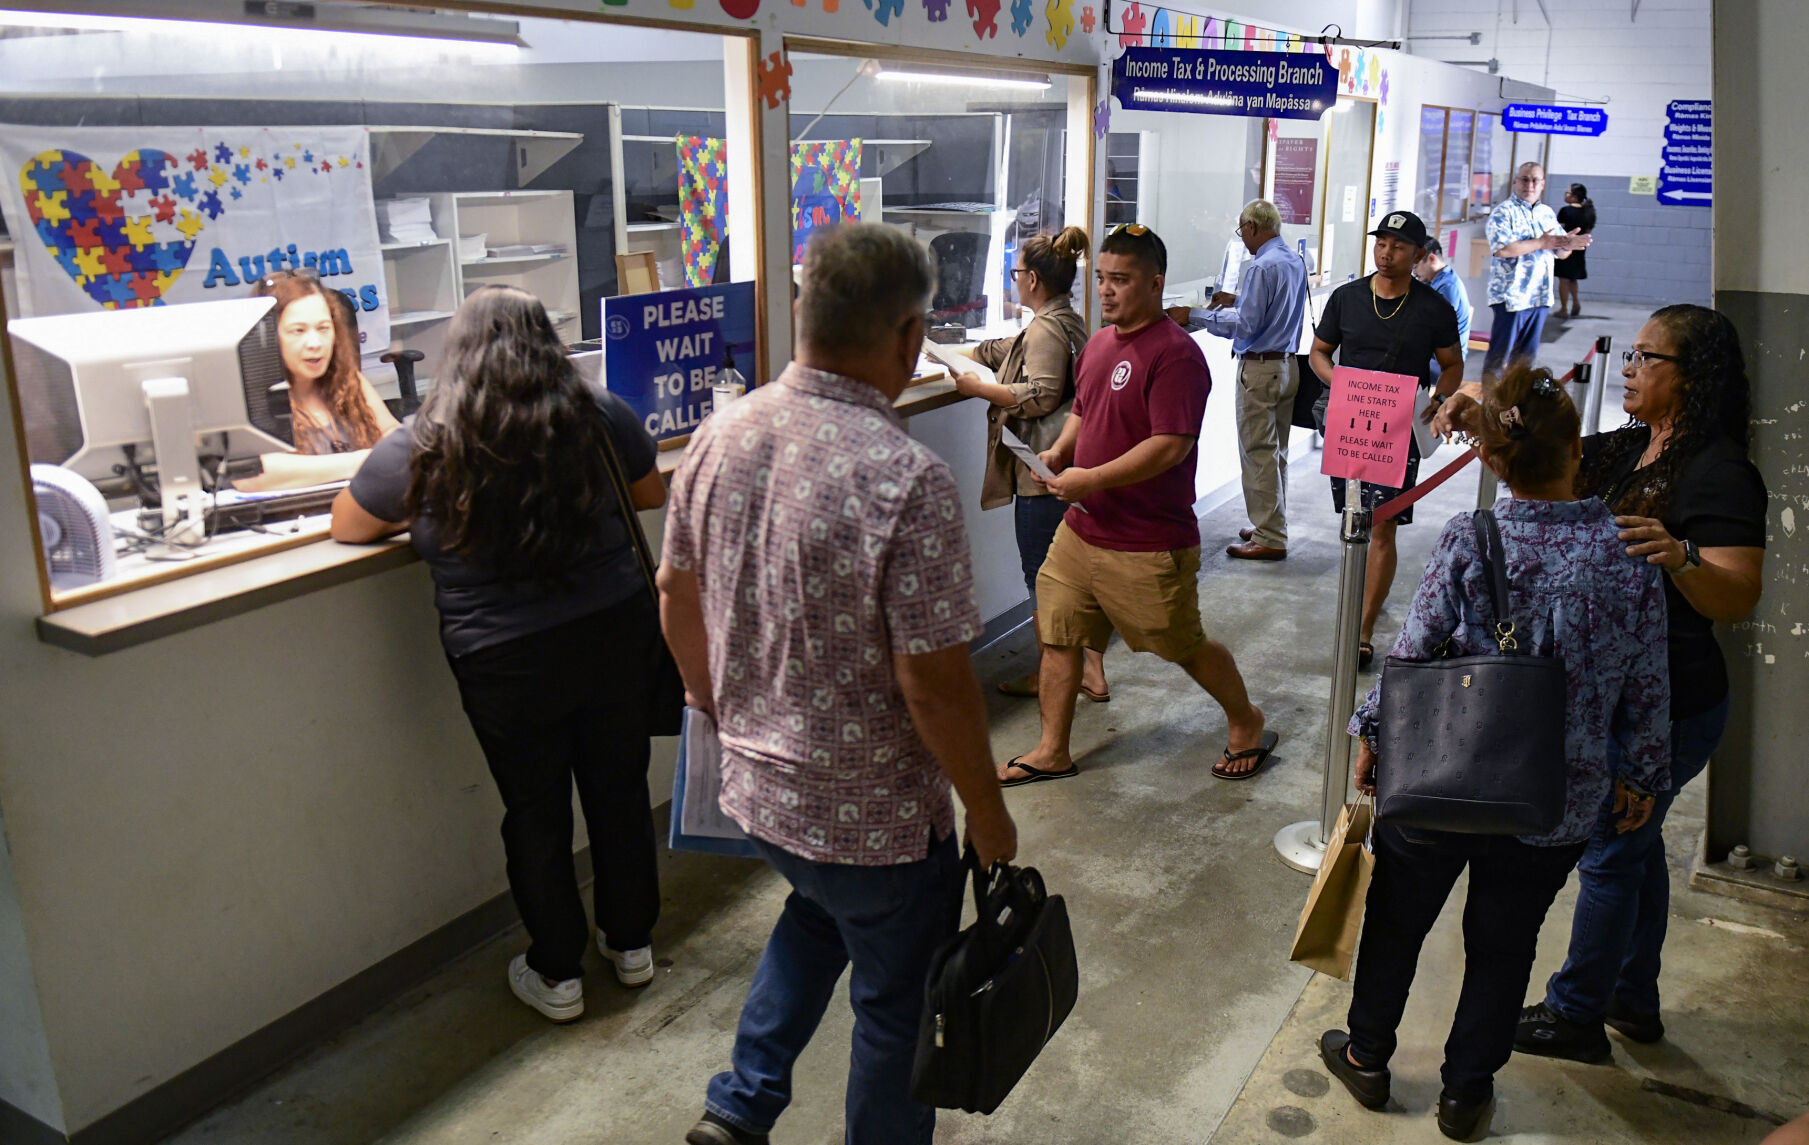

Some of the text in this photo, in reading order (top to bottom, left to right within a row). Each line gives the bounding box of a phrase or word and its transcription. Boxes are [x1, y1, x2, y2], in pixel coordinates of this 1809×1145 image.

[1126, 55, 1323, 88] Income Tax & Processing Branch
[1246, 96, 1264, 110] yan
[1266, 93, 1310, 112] Mapåssa
[1671, 102, 1712, 112] Complianc
[1509, 107, 1601, 122] Business Privilege Tax Branch
[791, 193, 830, 230] tism
[203, 244, 352, 288] Autism
[644, 296, 724, 330] PLEASE
[656, 332, 714, 363] WAIT
[654, 366, 716, 399] TO BE
[1348, 380, 1400, 394] INCOME TAX
[1347, 394, 1397, 408] LINE STARTS
[644, 401, 712, 436] CALLE
[1359, 409, 1380, 419] HERE
[1340, 435, 1394, 450] PLEASE WAIT
[1337, 448, 1394, 463] TO BE CALLED
